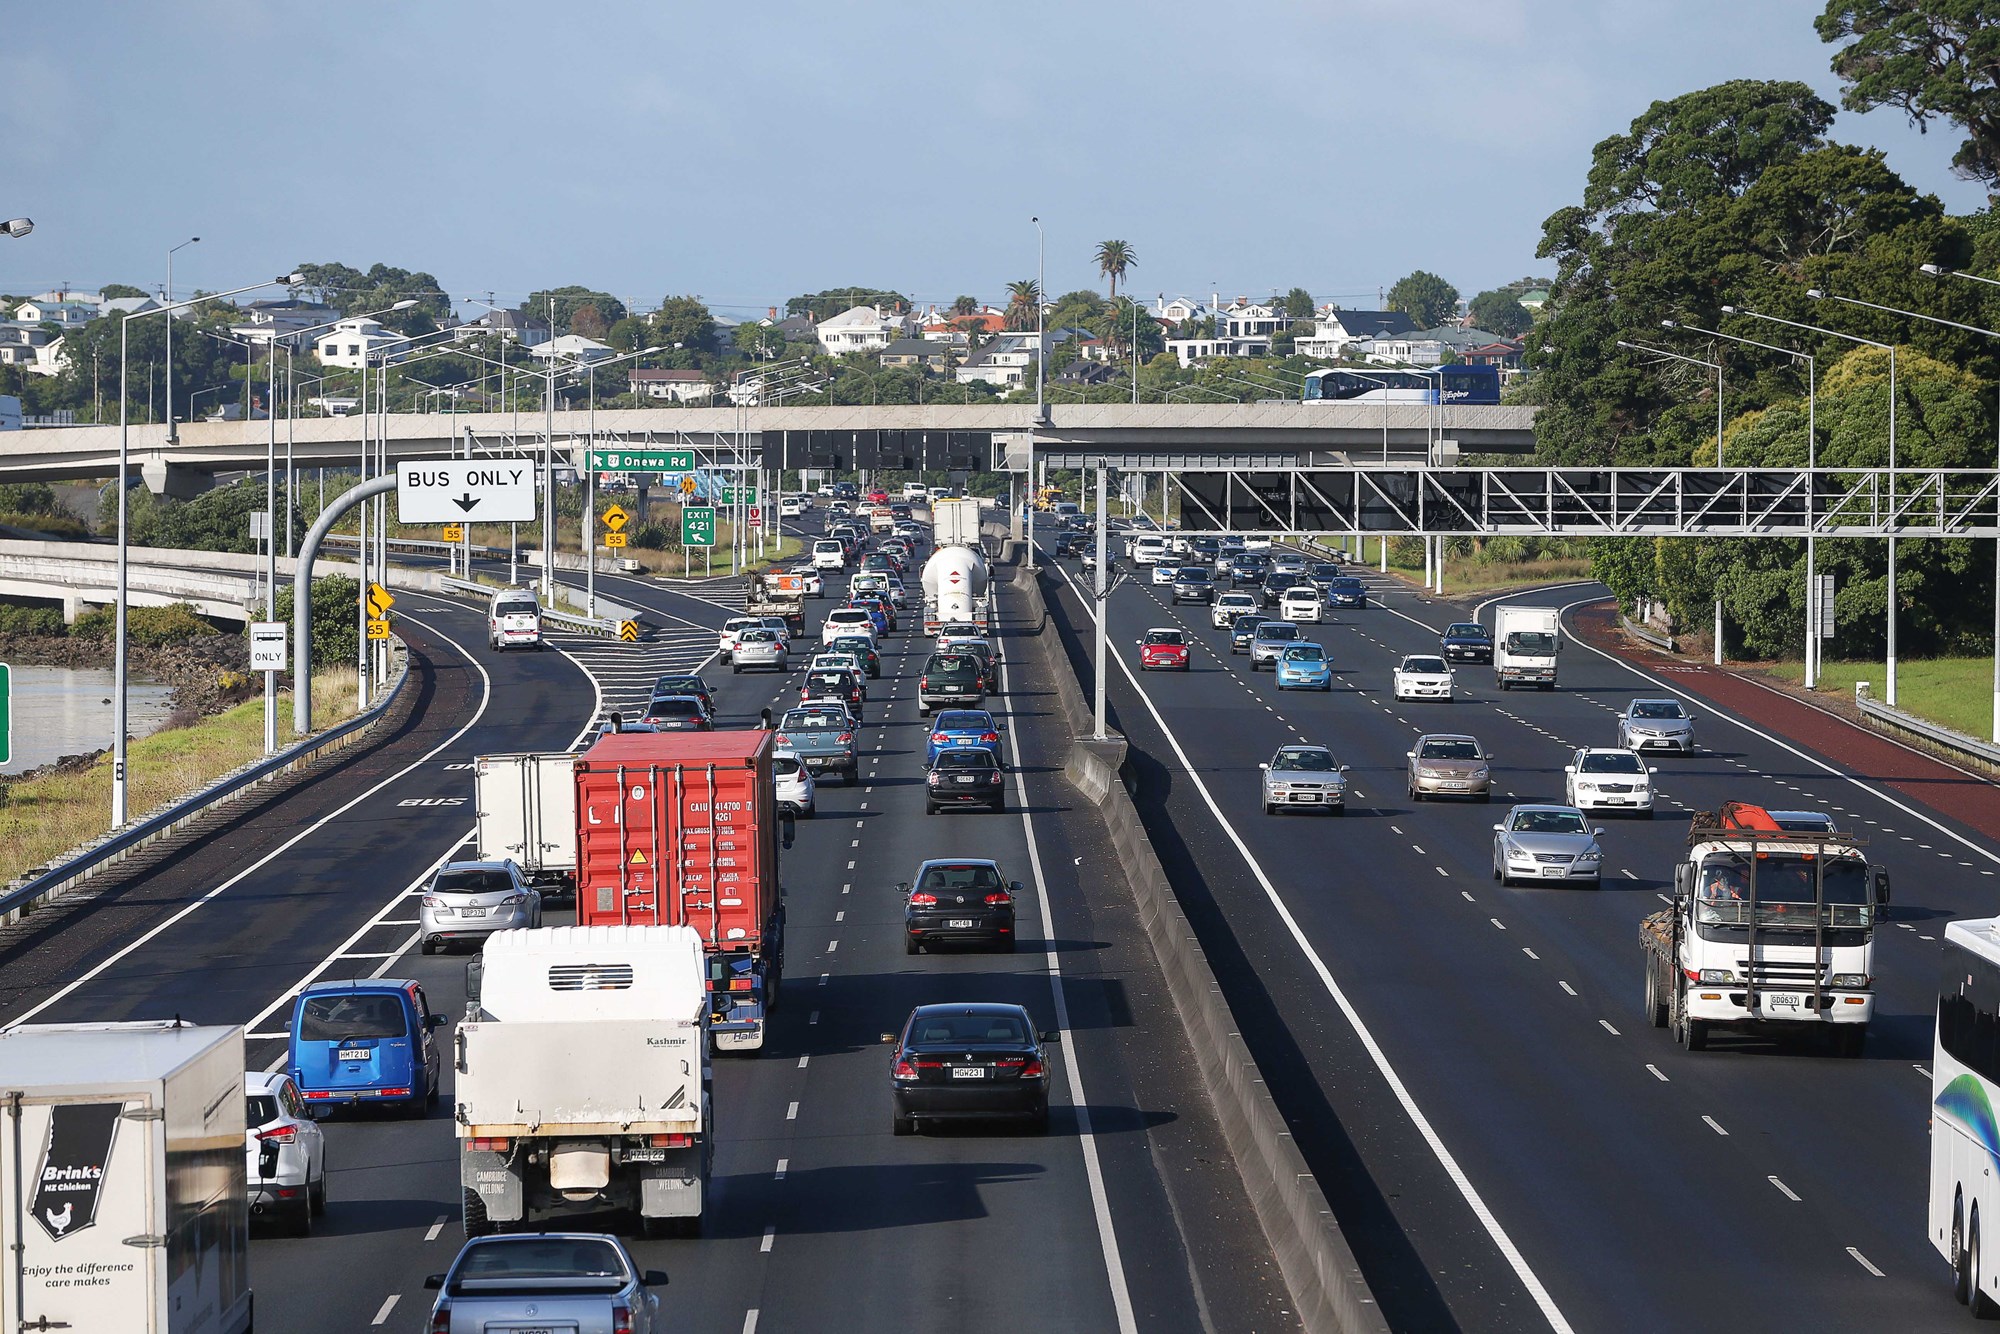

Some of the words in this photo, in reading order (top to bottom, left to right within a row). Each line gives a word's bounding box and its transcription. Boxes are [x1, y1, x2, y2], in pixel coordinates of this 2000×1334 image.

[609, 456, 618, 464] 27
[624, 456, 664, 467] Onewa
[671, 457, 686, 467] Rd
[408, 471, 450, 487] BUS
[466, 470, 523, 486] ONLY
[687, 511, 710, 519] EXIT
[688, 522, 710, 531] 421
[447, 530, 460, 539] 55
[609, 536, 622, 544] 55
[368, 625, 383, 635] 65
[255, 652, 281, 661] ONLY
[396, 797, 469, 807] BUS
[690, 803, 708, 812] CAIU
[715, 802, 741, 811] 414700
[715, 812, 732, 822] 42G1
[684, 843, 697, 851] TARE
[733, 1031, 760, 1040] Halls
[646, 1037, 687, 1045] Kashmir
[340, 1050, 369, 1059] HMT218
[954, 1068, 983, 1077] HGW231
[43, 1164, 102, 1181] Brink's
[476, 1171, 507, 1182] CAMBRIDGE
[655, 1167, 686, 1178] CAMBRIDGE
[44, 1183, 57, 1192] NZ
[57, 1182, 91, 1192] Chicken
[479, 1183, 505, 1194] WELDING
[22, 1265, 52, 1277] Enjoy
[55, 1264, 73, 1274] the
[76, 1263, 134, 1275] difference
[45, 1280, 71, 1288] care
[73, 1277, 111, 1287] makes
